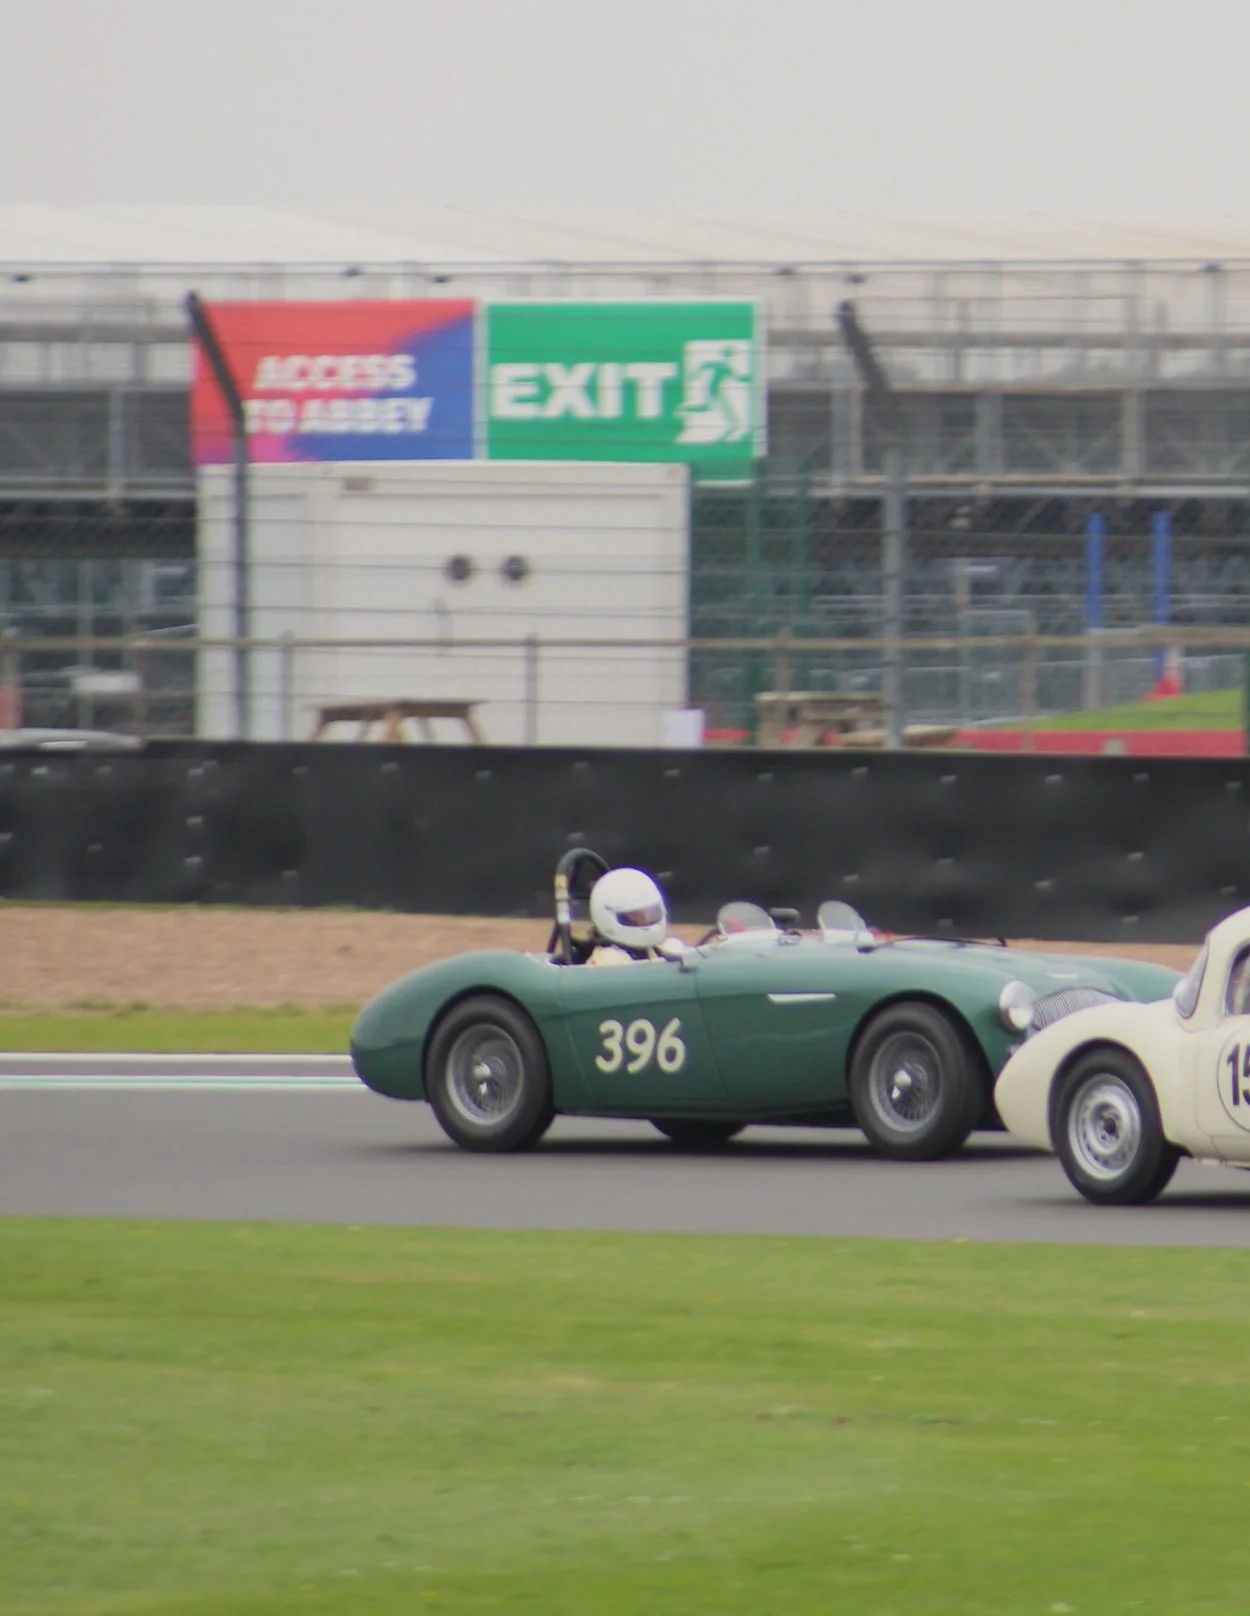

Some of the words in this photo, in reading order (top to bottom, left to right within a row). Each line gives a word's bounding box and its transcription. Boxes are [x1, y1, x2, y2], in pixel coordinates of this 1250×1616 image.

[252, 354, 417, 392] ACCESS
[491, 362, 678, 419] EXIT
[241, 399, 294, 434] TO
[299, 397, 434, 435] ABBEY
[595, 1017, 686, 1074] 396
